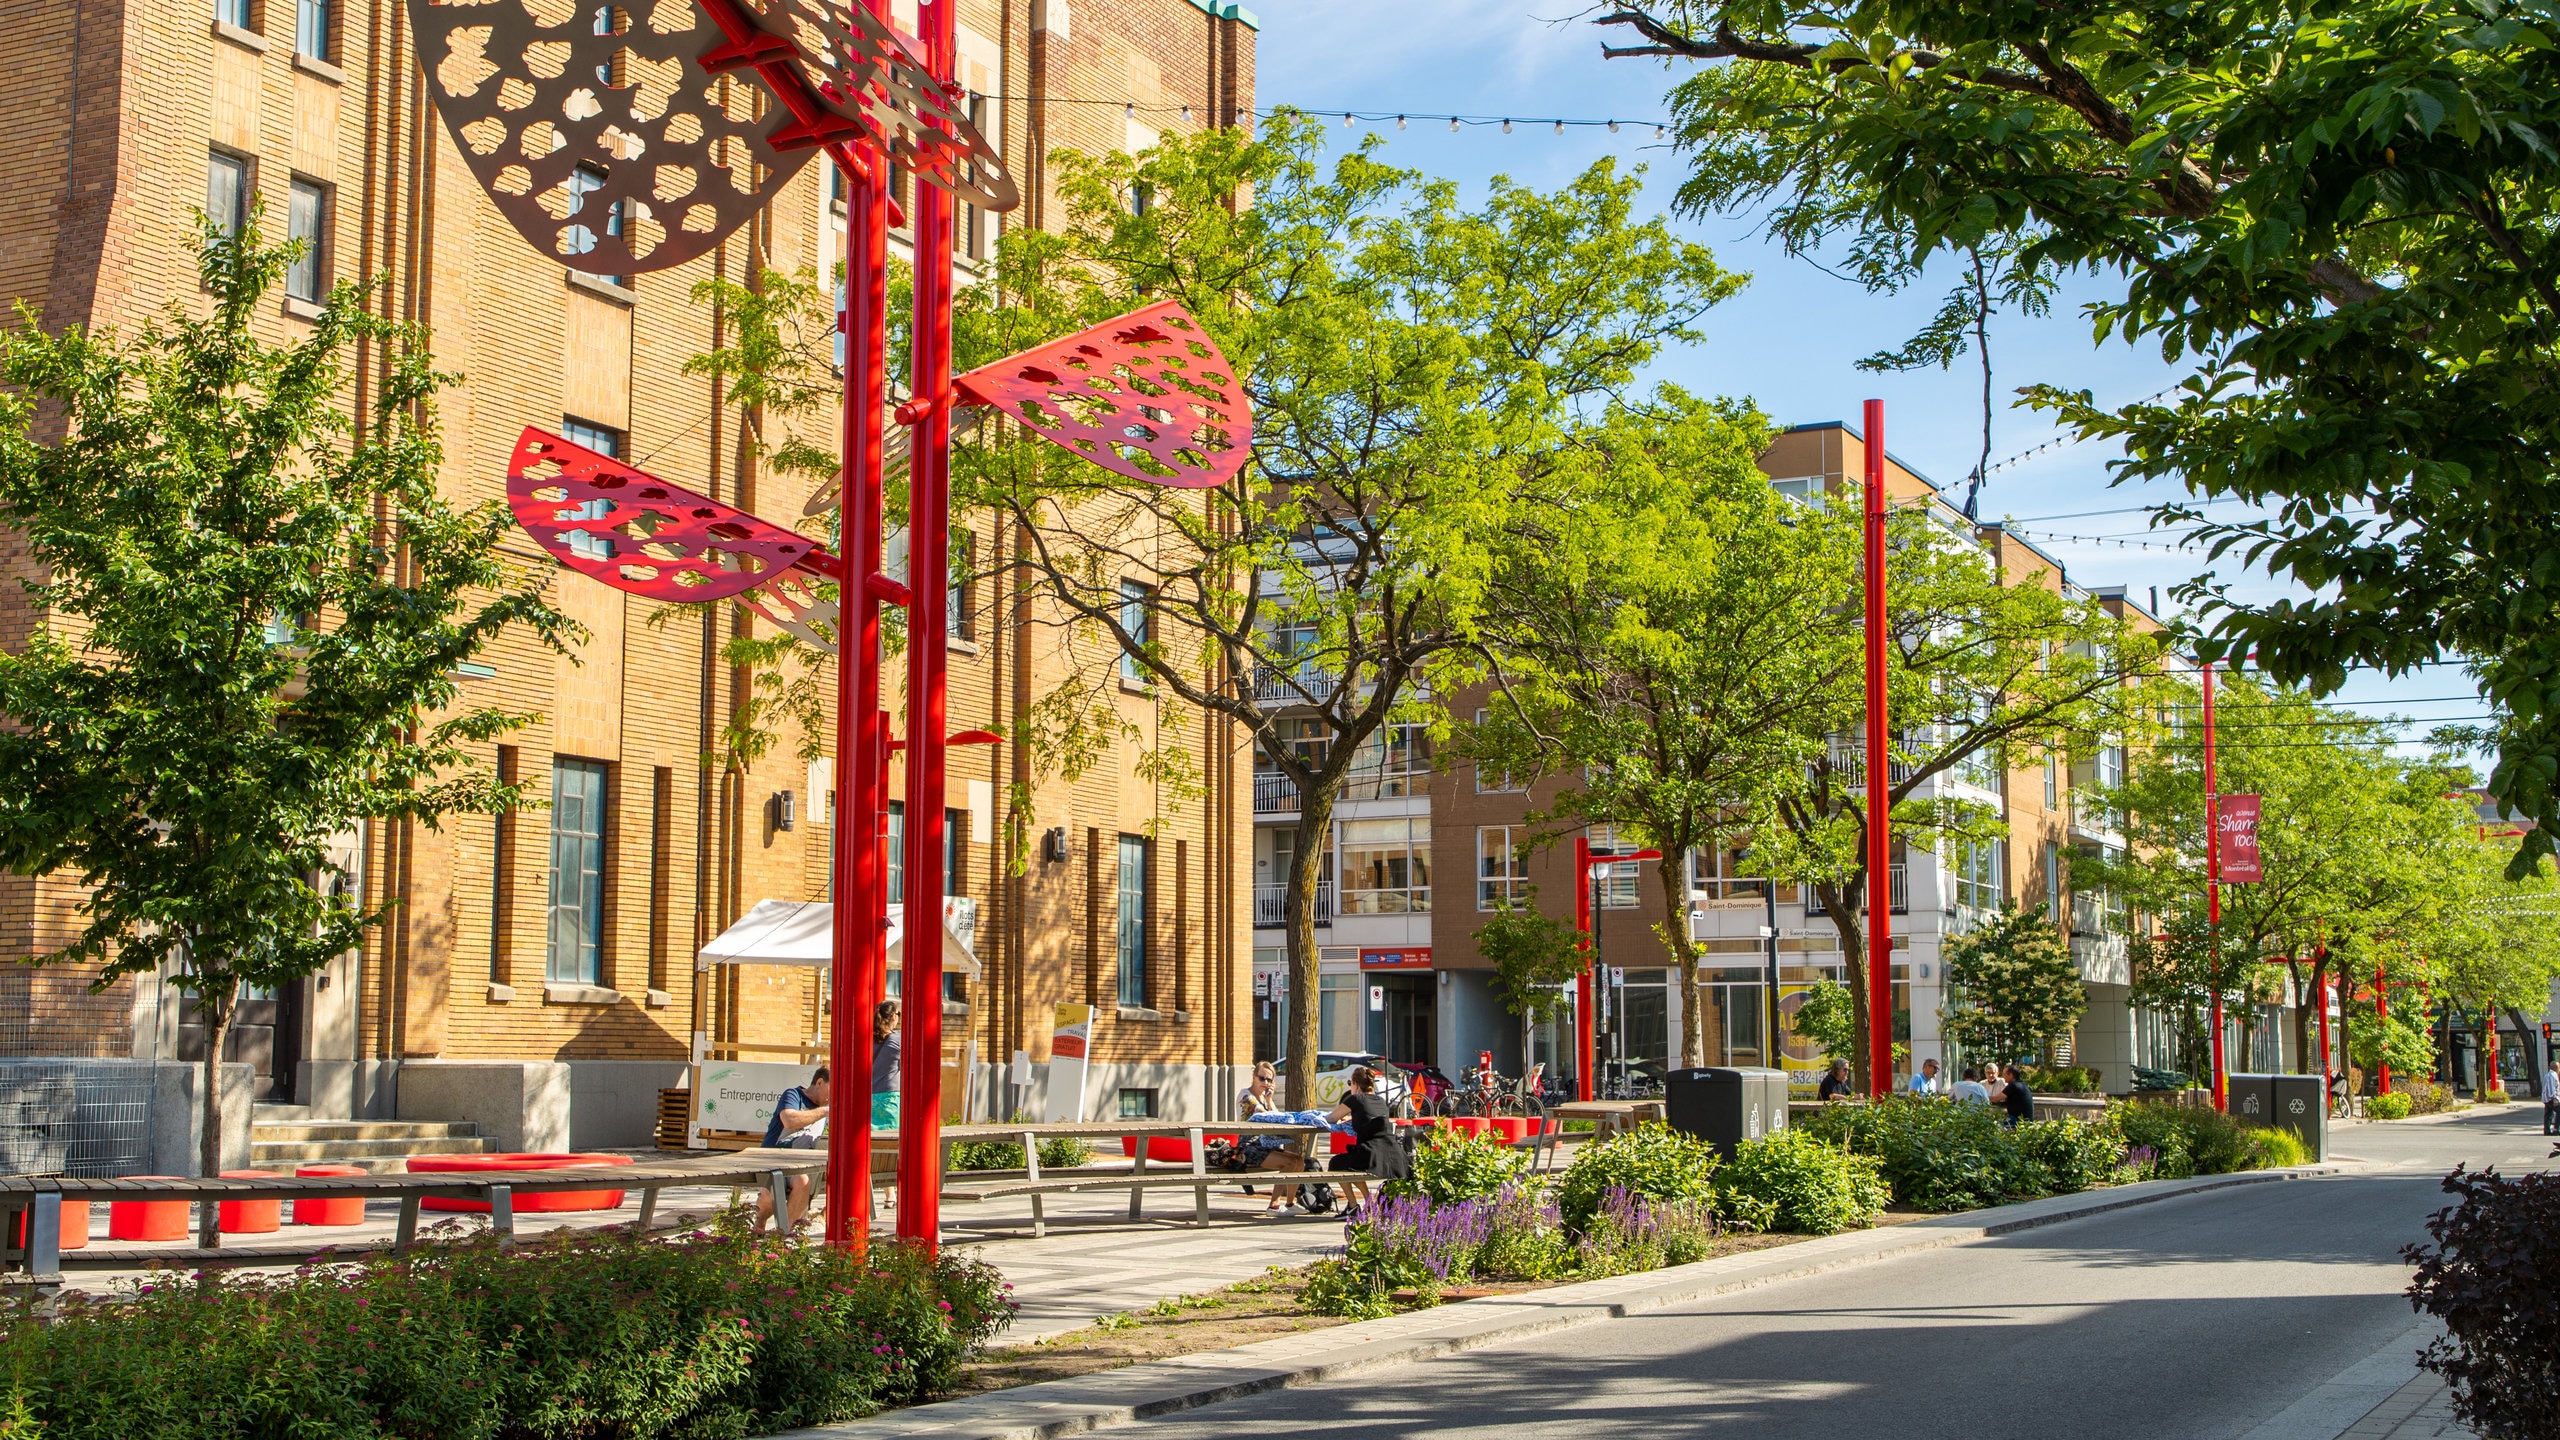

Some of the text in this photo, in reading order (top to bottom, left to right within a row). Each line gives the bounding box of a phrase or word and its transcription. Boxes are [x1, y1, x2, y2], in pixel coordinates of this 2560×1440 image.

[2234, 830, 2258, 847] rock
[1708, 902, 1762, 910] Saint-Dominique
[1789, 929, 1834, 937] Saint-Dominique
[720, 1088, 781, 1103] Entreprendre
